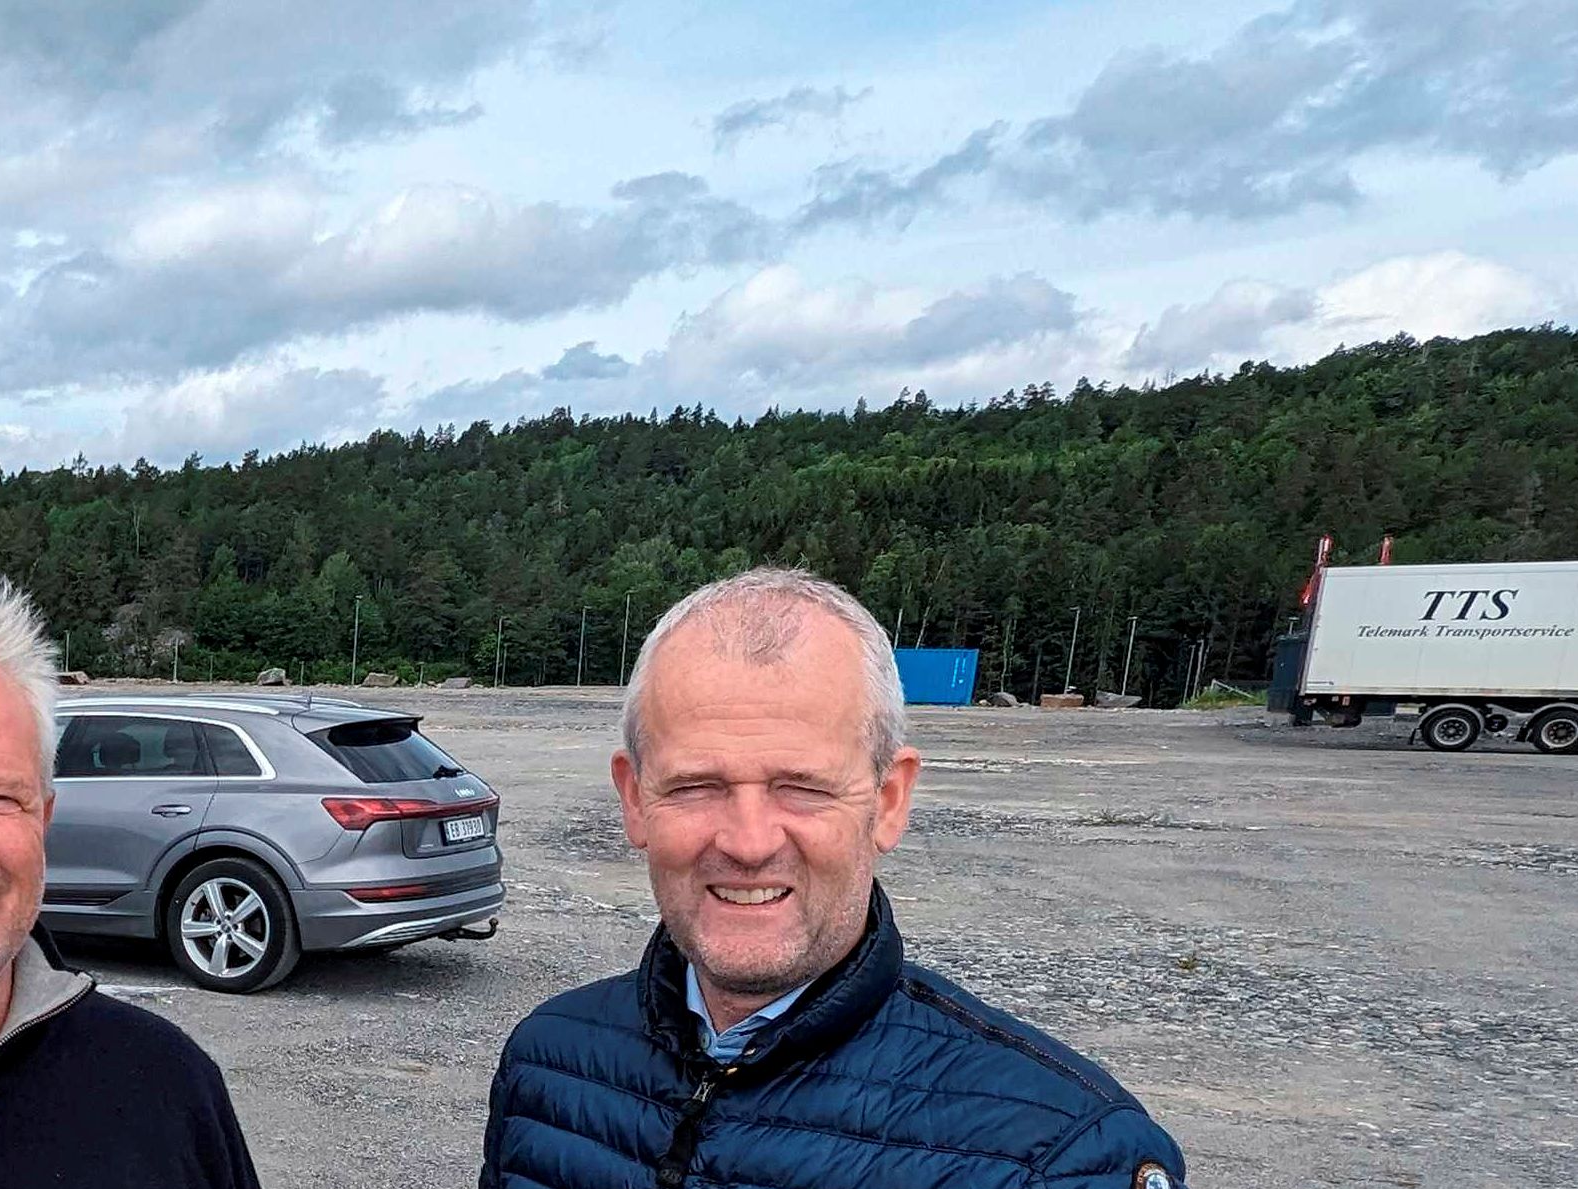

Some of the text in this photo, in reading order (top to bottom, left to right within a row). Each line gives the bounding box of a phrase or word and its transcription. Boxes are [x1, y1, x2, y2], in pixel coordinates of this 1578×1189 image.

[1419, 588, 1520, 622] TTS
[1356, 624, 1575, 641] Telemark Transportservice
